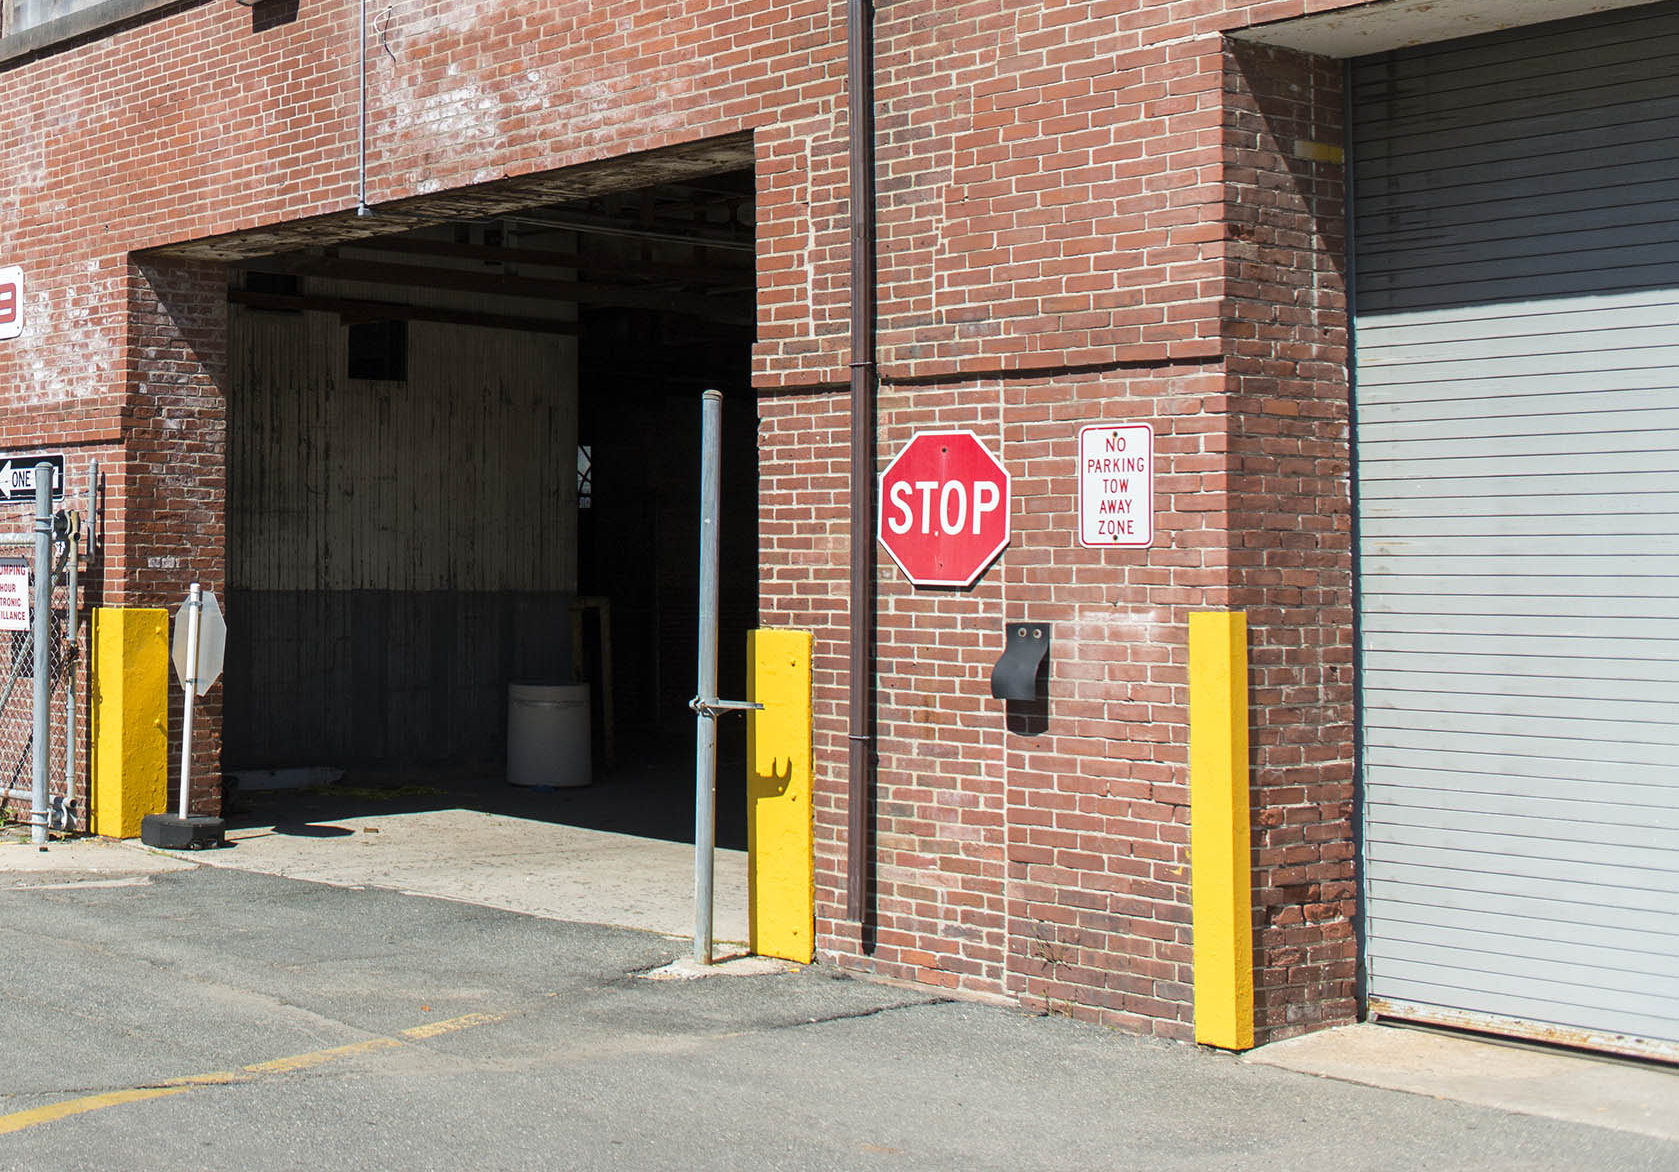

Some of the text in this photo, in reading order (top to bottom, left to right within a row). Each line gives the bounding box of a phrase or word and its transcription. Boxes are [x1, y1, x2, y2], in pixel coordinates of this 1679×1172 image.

[1106, 437, 1126, 452] NO
[1087, 457, 1144, 473] PARKING
[11, 470, 31, 488] ONE
[1103, 479, 1129, 494] TOW
[887, 479, 1001, 536] STOP
[1099, 499, 1132, 514] AWAY
[1098, 520, 1134, 535] ZONE
[0, 583, 17, 593] HOUR
